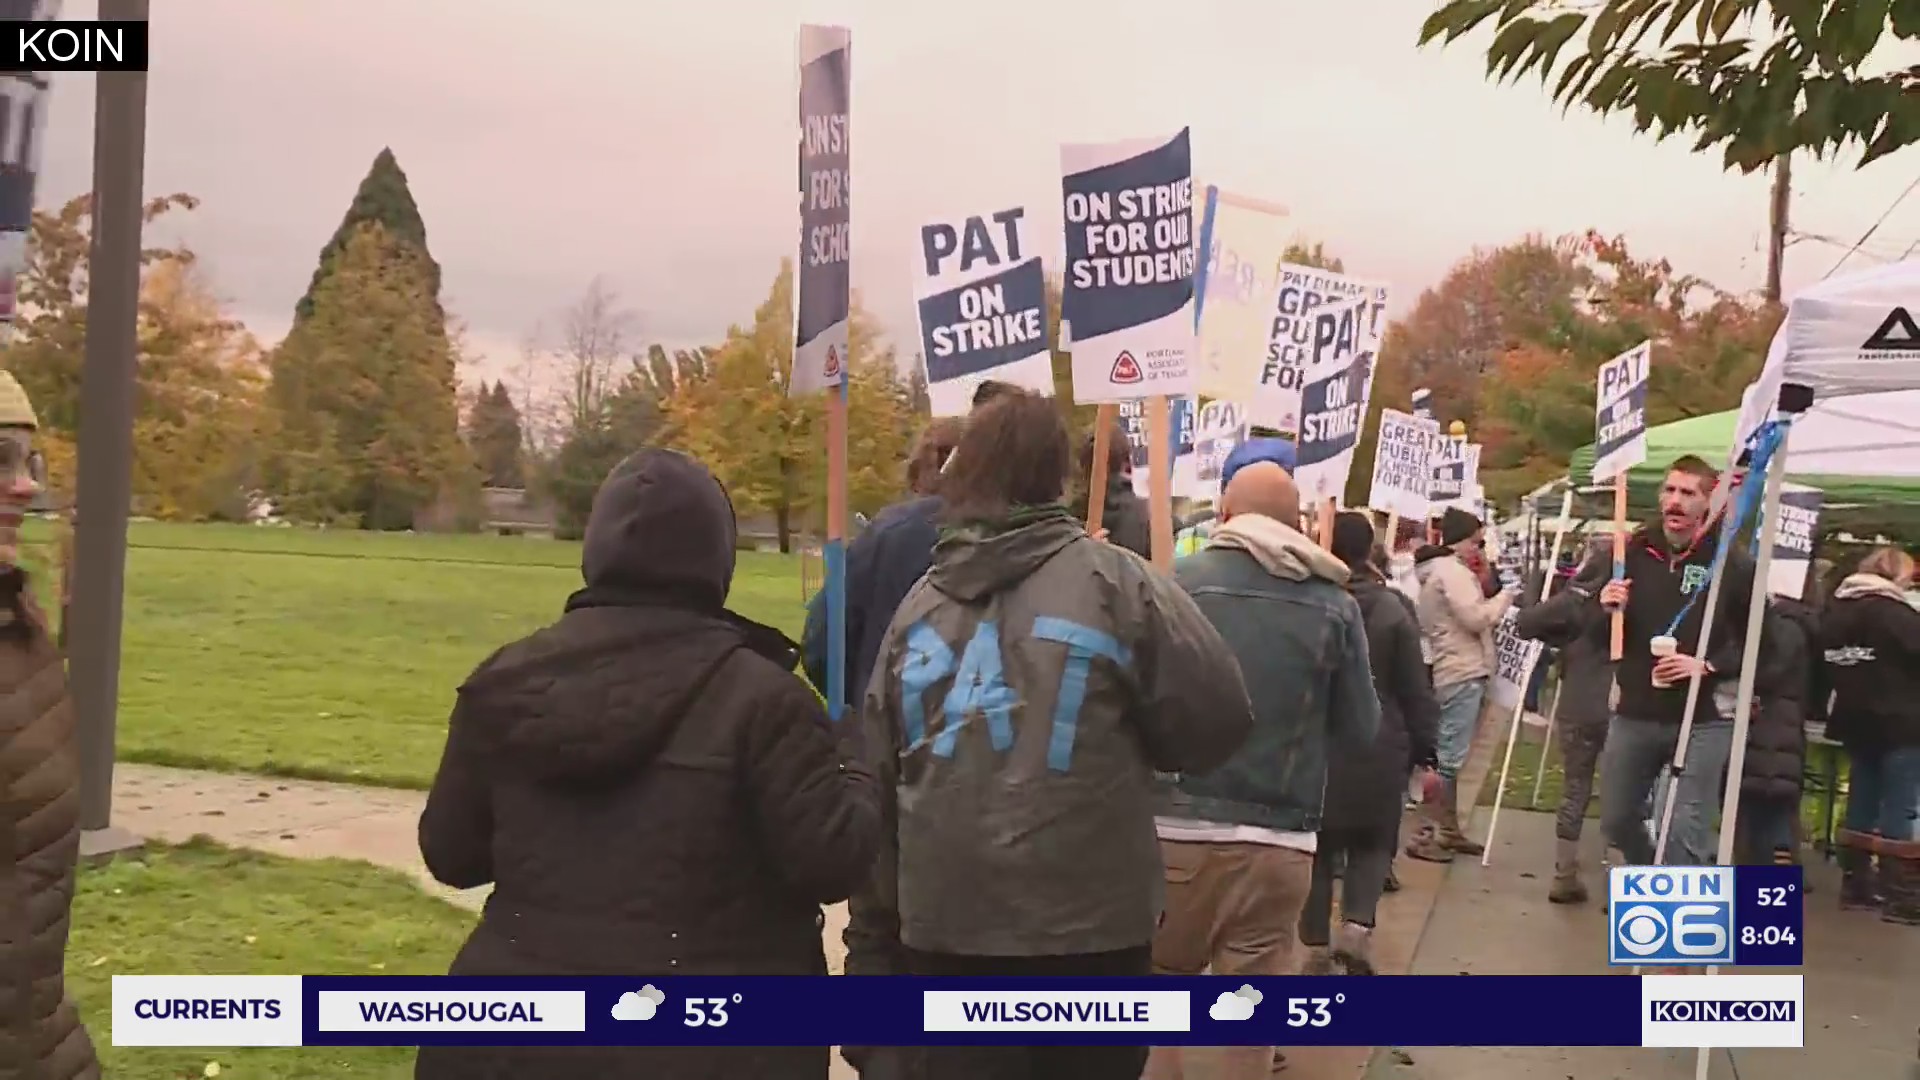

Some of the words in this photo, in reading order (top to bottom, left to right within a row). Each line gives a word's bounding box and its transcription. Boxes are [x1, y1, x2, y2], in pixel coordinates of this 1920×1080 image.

[805, 115, 829, 155] ON
[811, 168, 841, 210] FOR
[1066, 191, 1111, 222] ON
[1118, 177, 1191, 220] STRIKE
[921, 206, 1024, 277] PAT
[1086, 221, 1148, 254] FOR
[1073, 247, 1193, 289] STUDENTS
[1282, 270, 1310, 288] PAT
[959, 283, 1006, 320] ON
[932, 308, 1041, 357] STRIKE
[1312, 298, 1367, 364] PAT
[1325, 377, 1349, 409] ON
[1604, 351, 1645, 396] PAT
[1303, 402, 1358, 443] STRIKE
[1382, 422, 1435, 450] GREAT
[901, 616, 1132, 773] PAT
